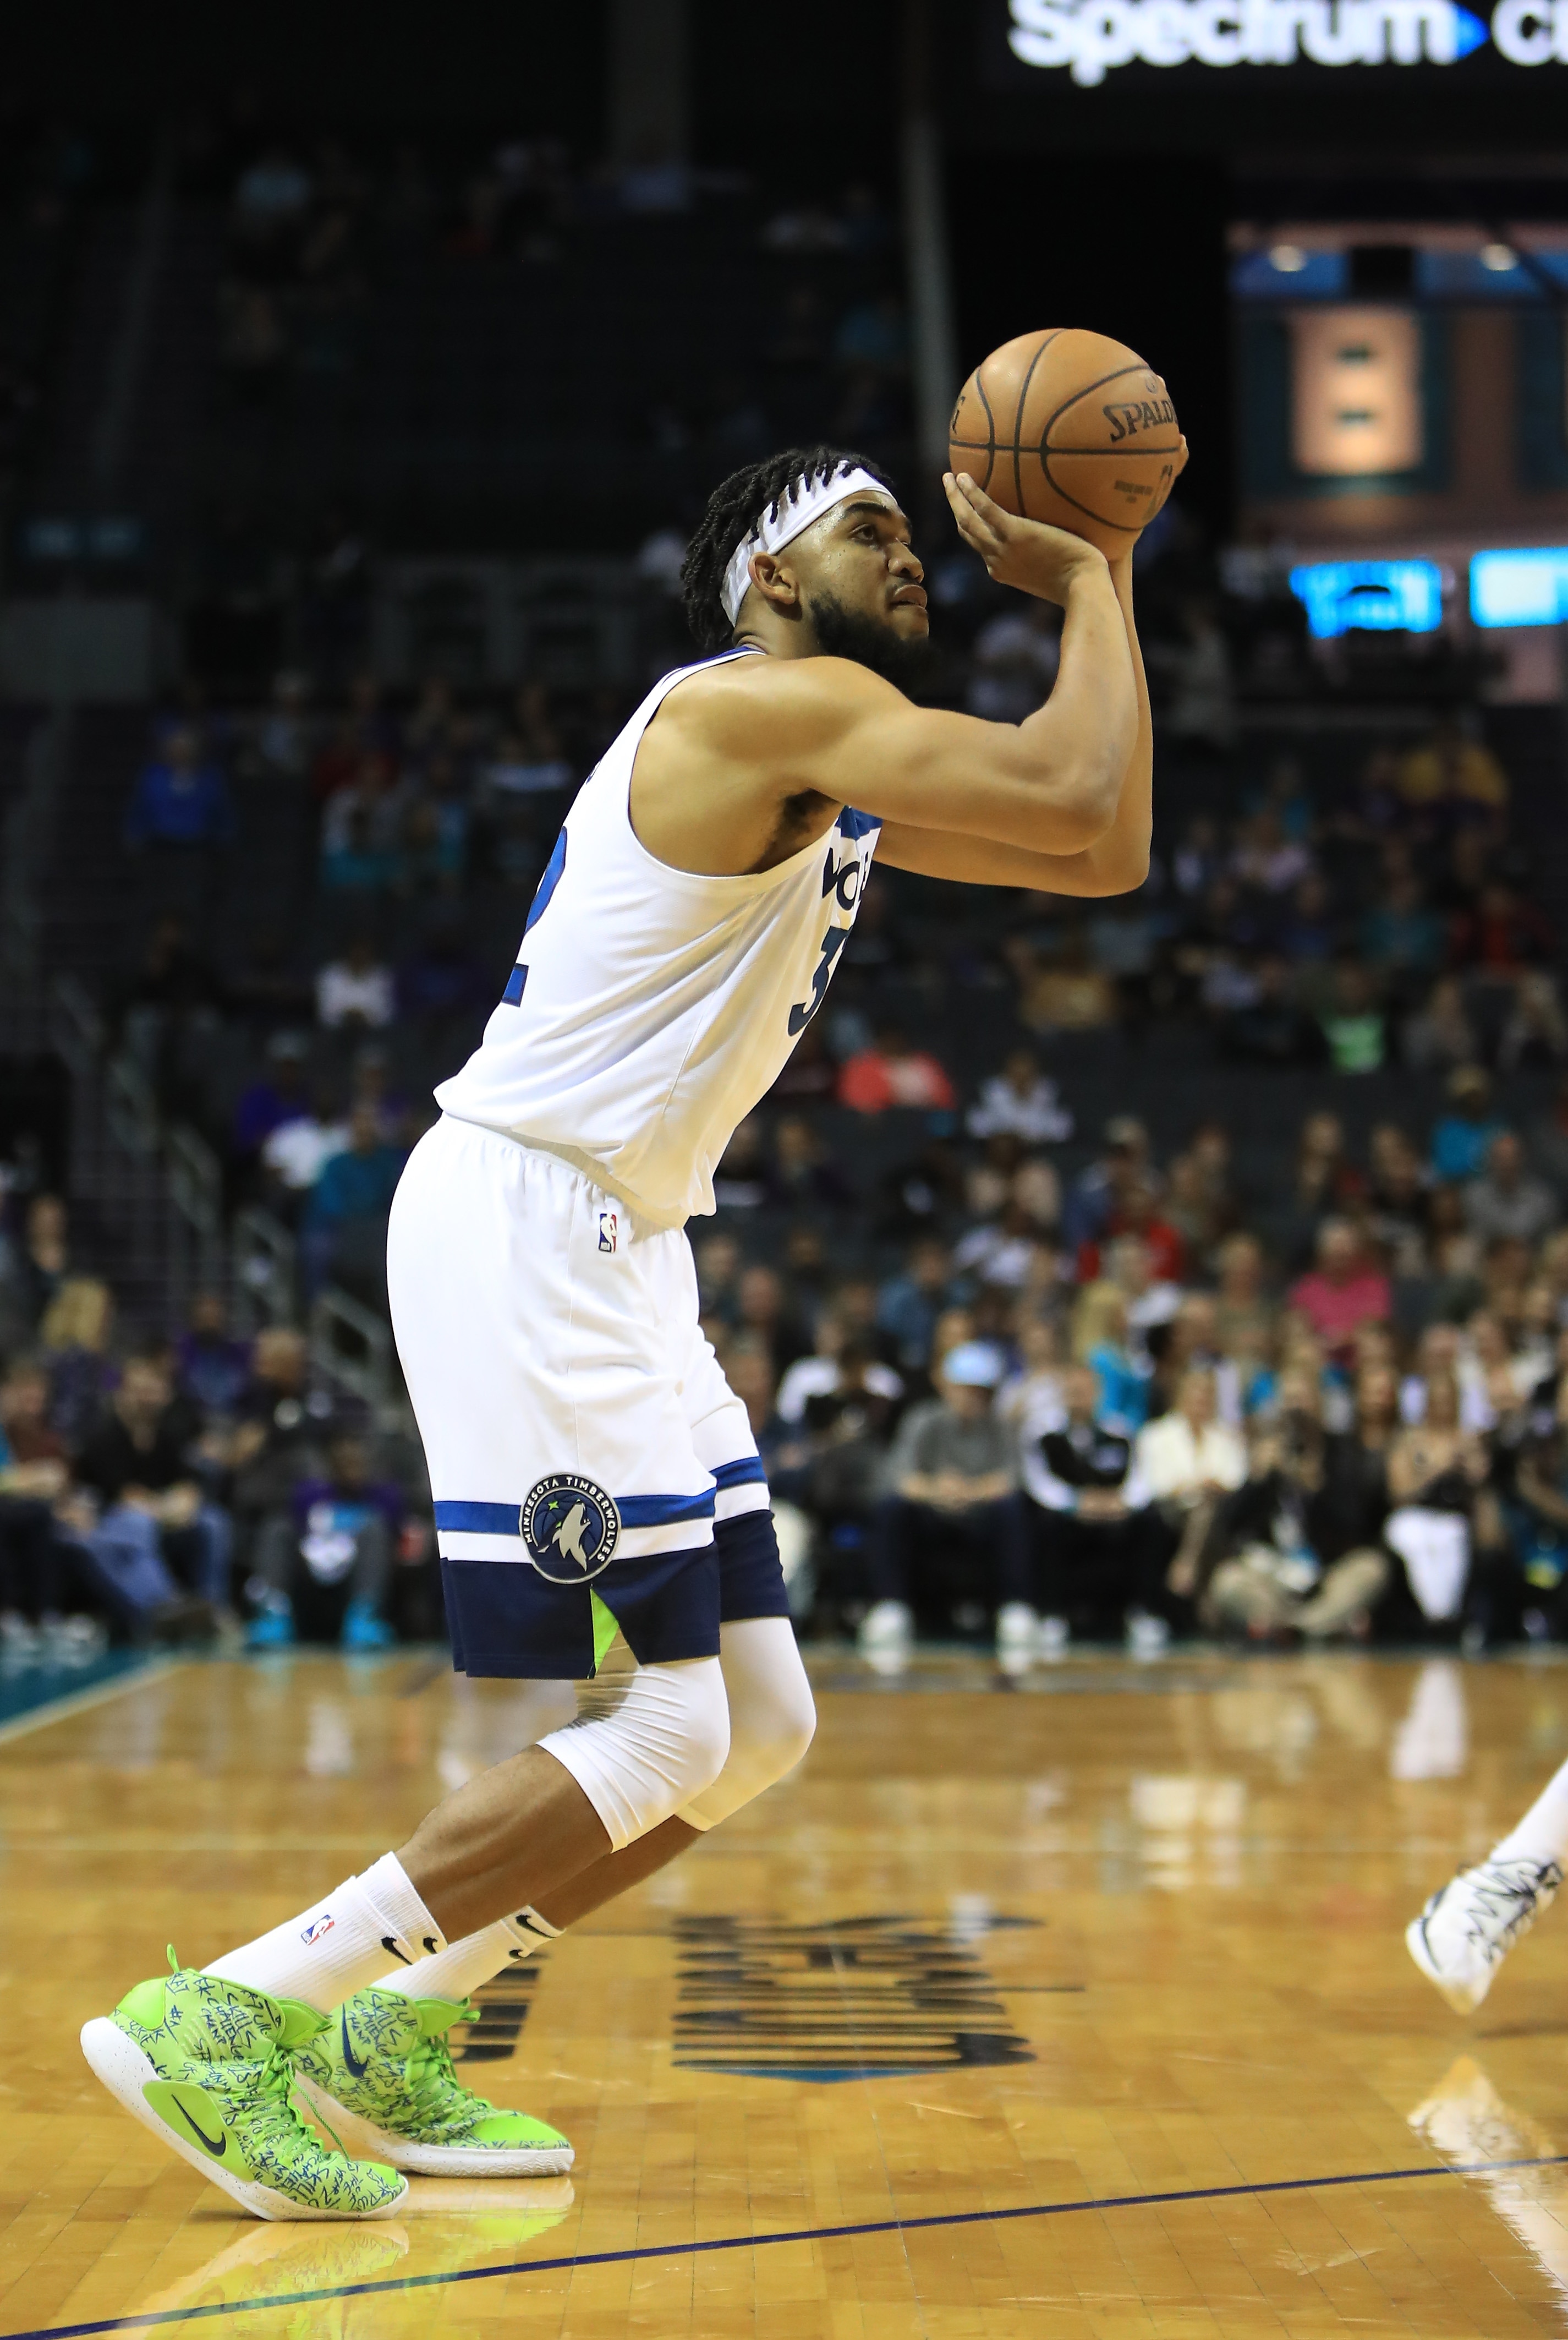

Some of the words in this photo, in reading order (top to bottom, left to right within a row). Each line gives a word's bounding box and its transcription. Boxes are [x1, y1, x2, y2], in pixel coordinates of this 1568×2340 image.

[1008, 0, 1456, 88] Spectrum
[522, 1478, 560, 1544] MINNESOTA
[566, 1476, 616, 1562] TIMBERWOLVES
